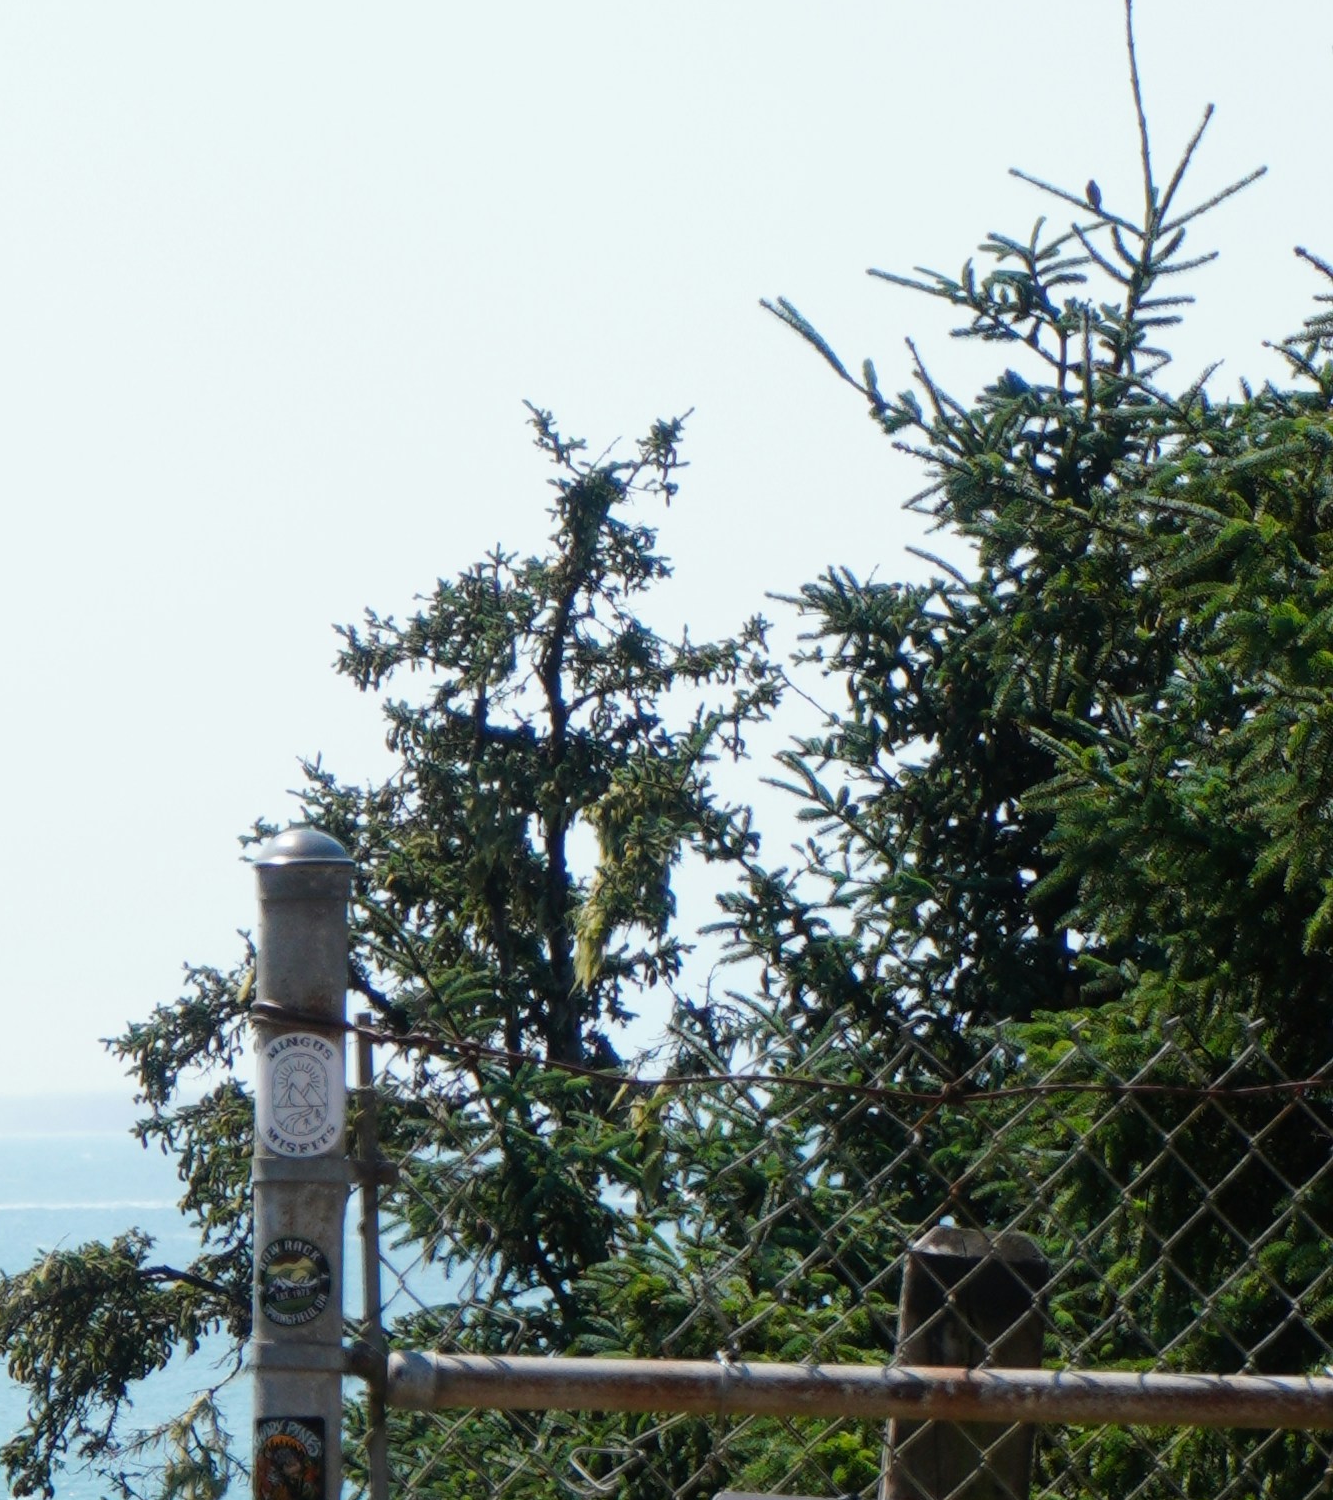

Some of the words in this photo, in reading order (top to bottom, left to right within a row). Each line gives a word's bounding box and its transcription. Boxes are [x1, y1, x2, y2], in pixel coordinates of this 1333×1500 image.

[267, 1036, 333, 1061] MINGUS
[266, 1123, 335, 1153] MISFITS
[284, 1240, 320, 1261] RACK
